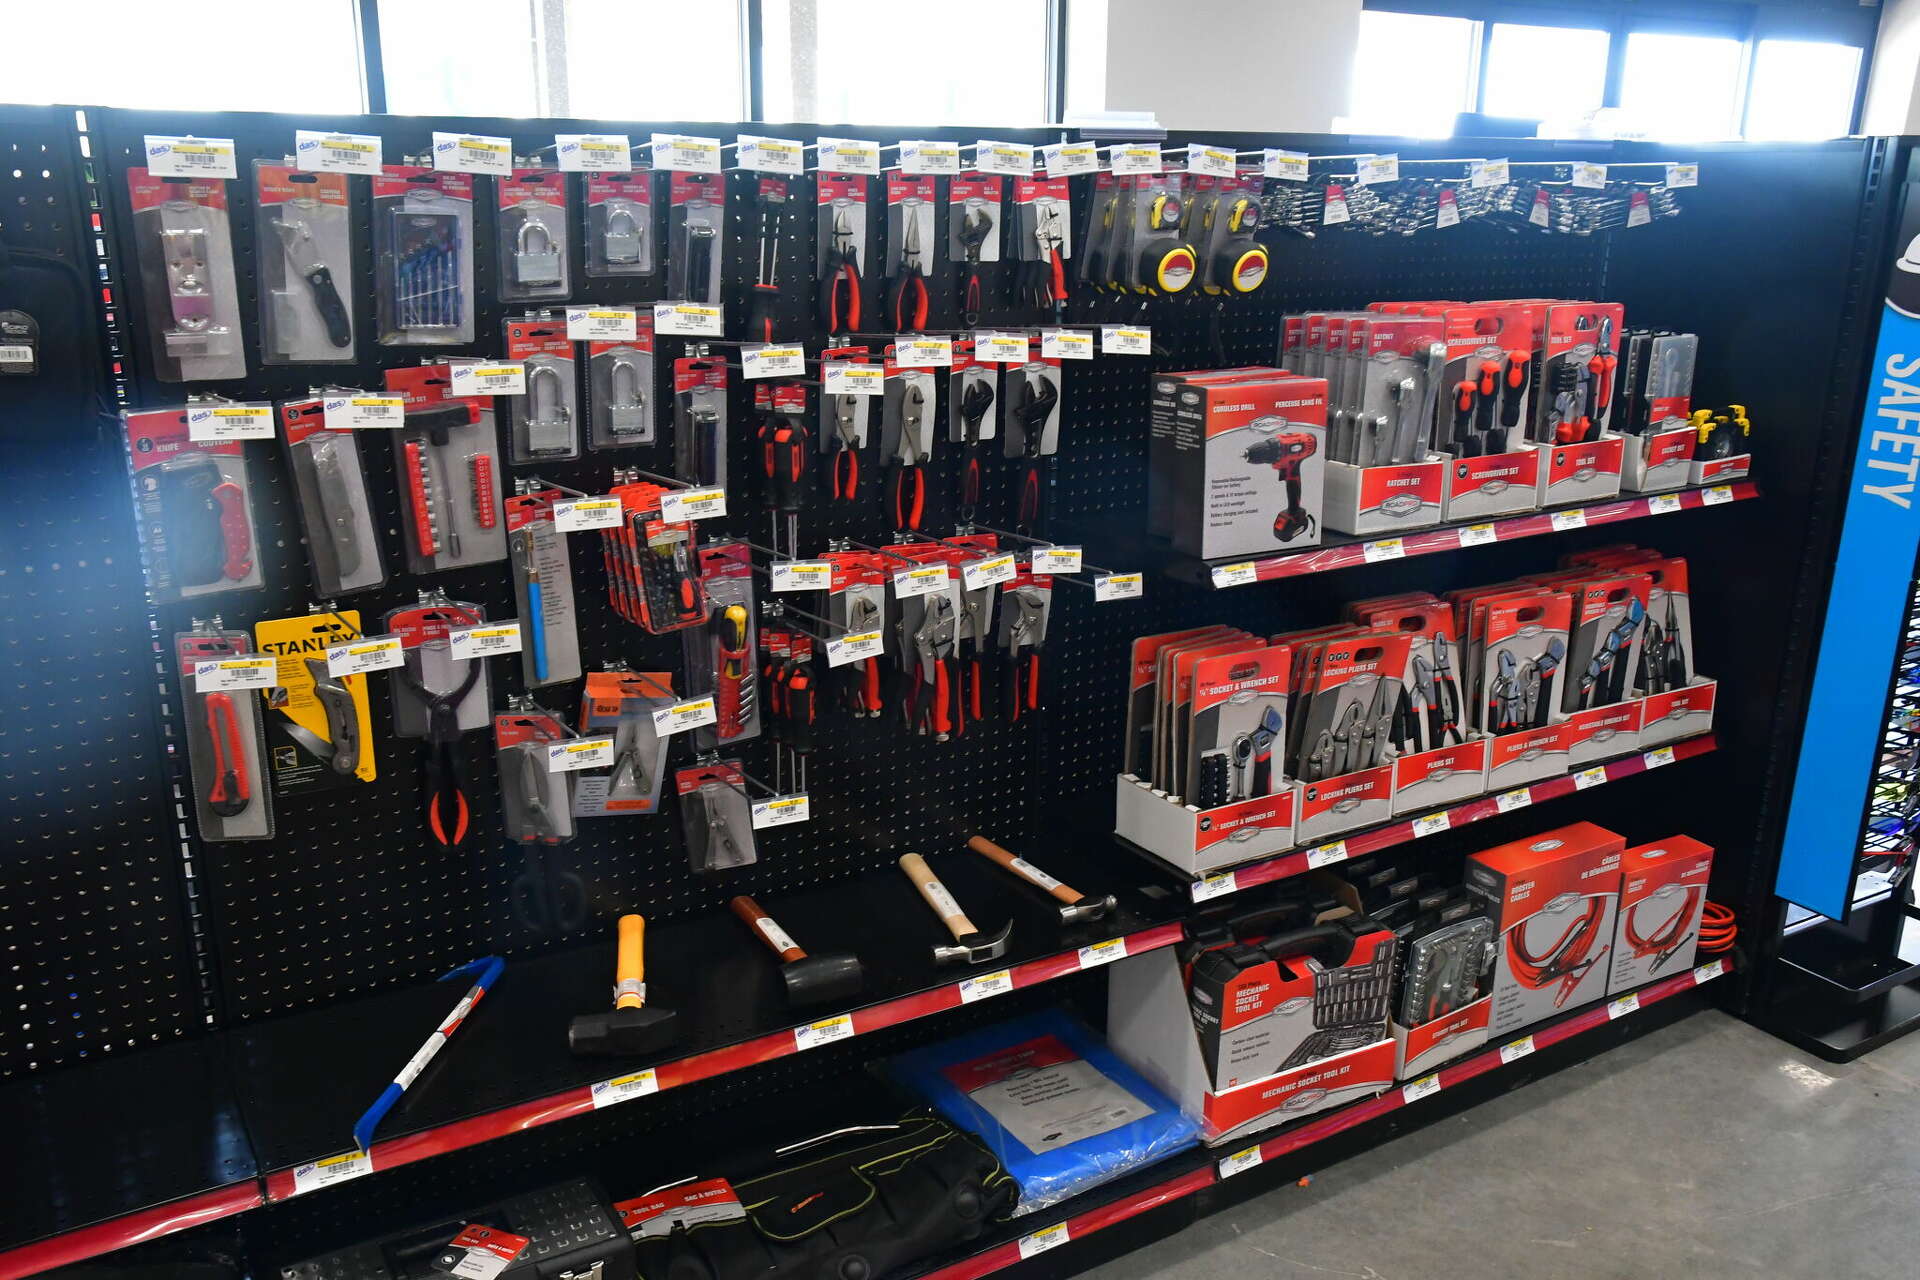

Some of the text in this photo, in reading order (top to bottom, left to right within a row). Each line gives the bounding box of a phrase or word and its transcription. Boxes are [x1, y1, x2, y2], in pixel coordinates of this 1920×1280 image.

[1447, 336, 1497, 346] SCREWDRIVER SET
[1213, 403, 1256, 413] CORDLESS DRILL
[1862, 353, 1920, 509] SAFETY
[156, 443, 180, 452] KNIFE
[1575, 456, 1596, 466] TOOL SET
[1471, 467, 1519, 479] SCREWDRIVER SET
[1386, 477, 1420, 487] RATCHET SET
[1323, 662, 1378, 677] LOCKING PLIERS SET
[1209, 685, 1234, 695] SOCKET
[1240, 679, 1267, 690] WRENCH
[1267, 675, 1280, 685] SET
[1426, 757, 1455, 769] PLIERS SET
[1320, 781, 1375, 800] LOCKING PLIERS SET
[1220, 820, 1239, 830] SOCKET
[1245, 812, 1266, 824] WRENCH
[1266, 810, 1276, 818] SET
[1511, 880, 1535, 894] BOOSTER
[1510, 891, 1530, 903] CABLES
[1236, 983, 1270, 998] MECHANIC
[1235, 993, 1260, 1006] SOCKET
[1235, 1000, 1263, 1014] TOOL KIT
[1262, 1065, 1350, 1099] MECHANIC SOCKET TOOL KIT
[1285, 1092, 1323, 1108] ROADPRO
[684, 1194, 698, 1203] SAC
[633, 1202, 665, 1215] TOOL BAG
